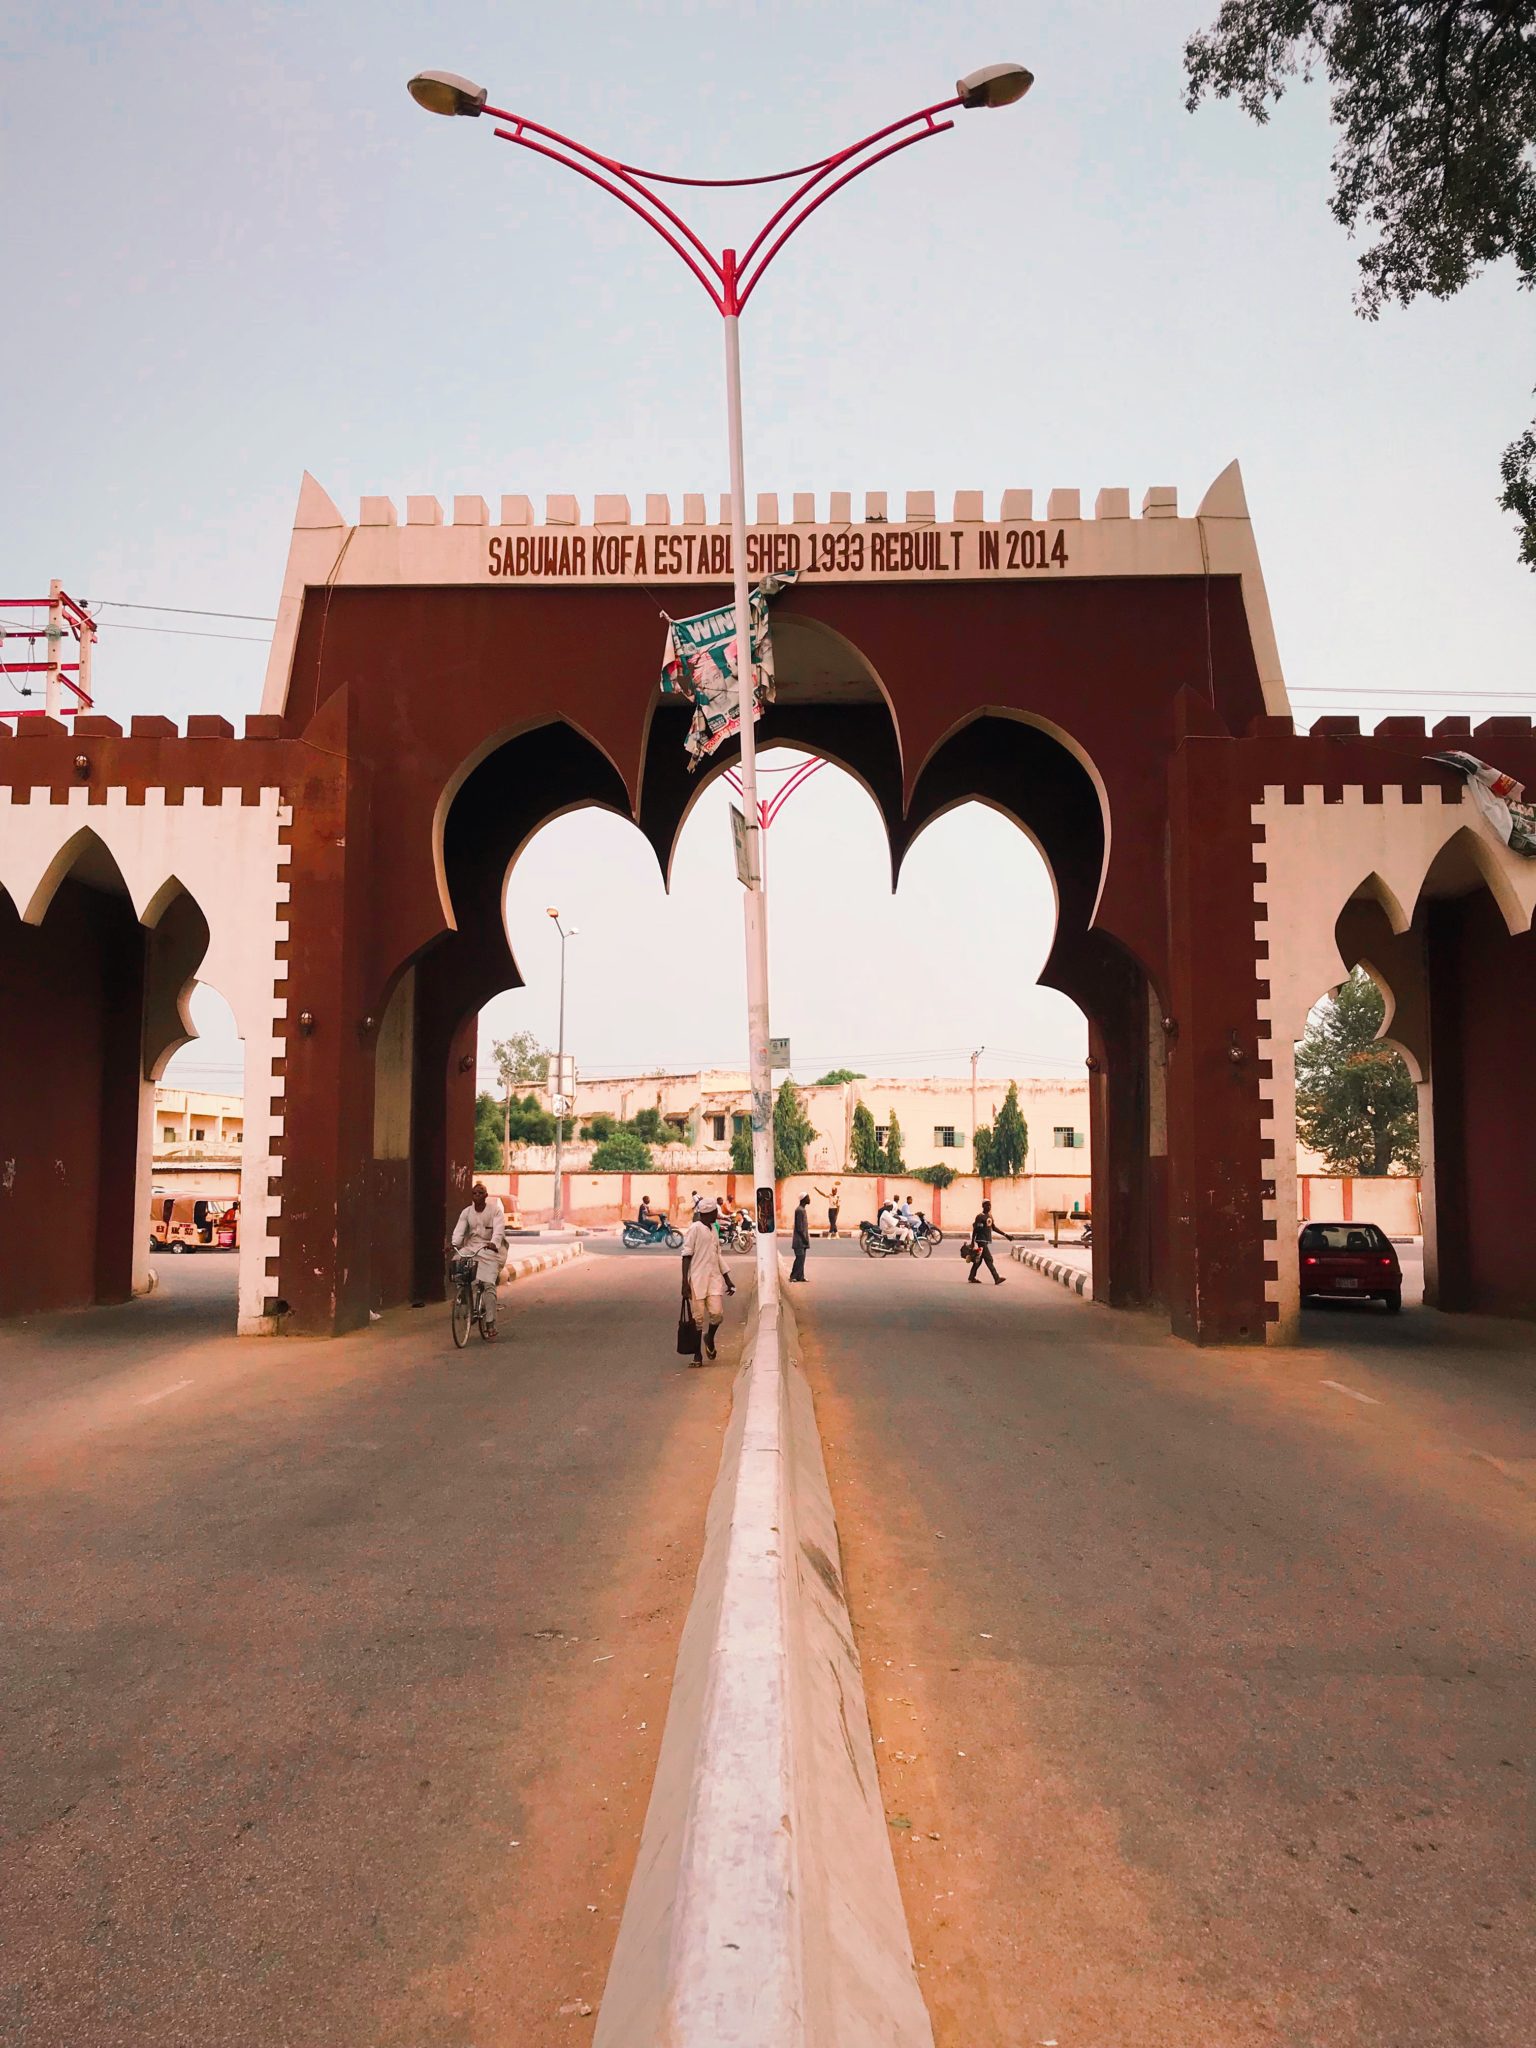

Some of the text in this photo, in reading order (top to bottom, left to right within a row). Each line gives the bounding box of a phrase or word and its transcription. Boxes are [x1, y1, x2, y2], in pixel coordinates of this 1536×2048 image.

[488, 528, 1069, 577] SABUWAR KOFA ESTABLSHED 1933 REBUILT IN 2014
[686, 609, 737, 643] WIN
